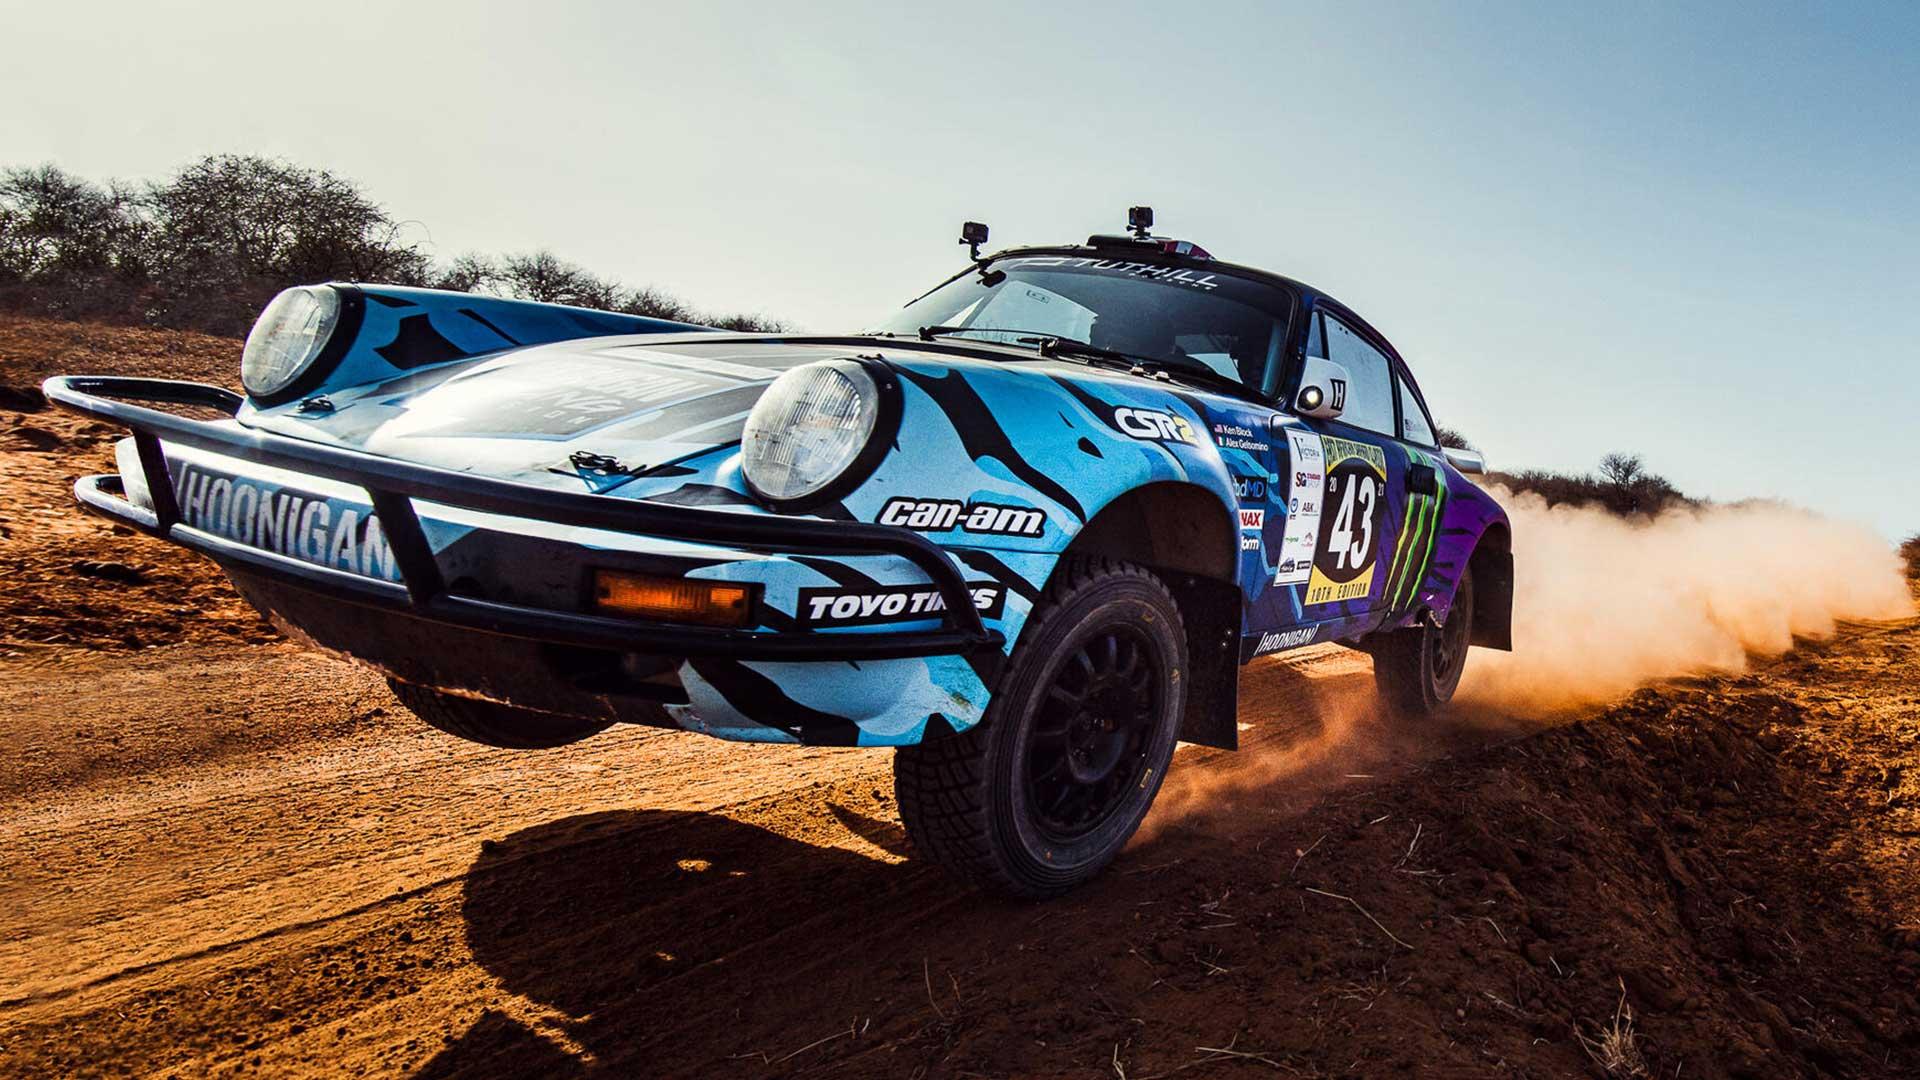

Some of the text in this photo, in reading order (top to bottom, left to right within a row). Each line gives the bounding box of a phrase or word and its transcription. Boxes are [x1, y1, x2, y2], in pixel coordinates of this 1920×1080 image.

[1075, 257, 1218, 287] TUTHILL
[1114, 407, 1199, 446] CSR2
[1223, 424, 1253, 437] Ken Block
[1226, 437, 1239, 448] Alex
[1233, 476, 1265, 498] bdMD
[1329, 477, 1337, 493] 20
[880, 500, 1043, 534] can-am
[1328, 474, 1375, 570] 43
[809, 588, 998, 620] TOYO TIS
[1311, 583, 1367, 602] 10TH EDITION
